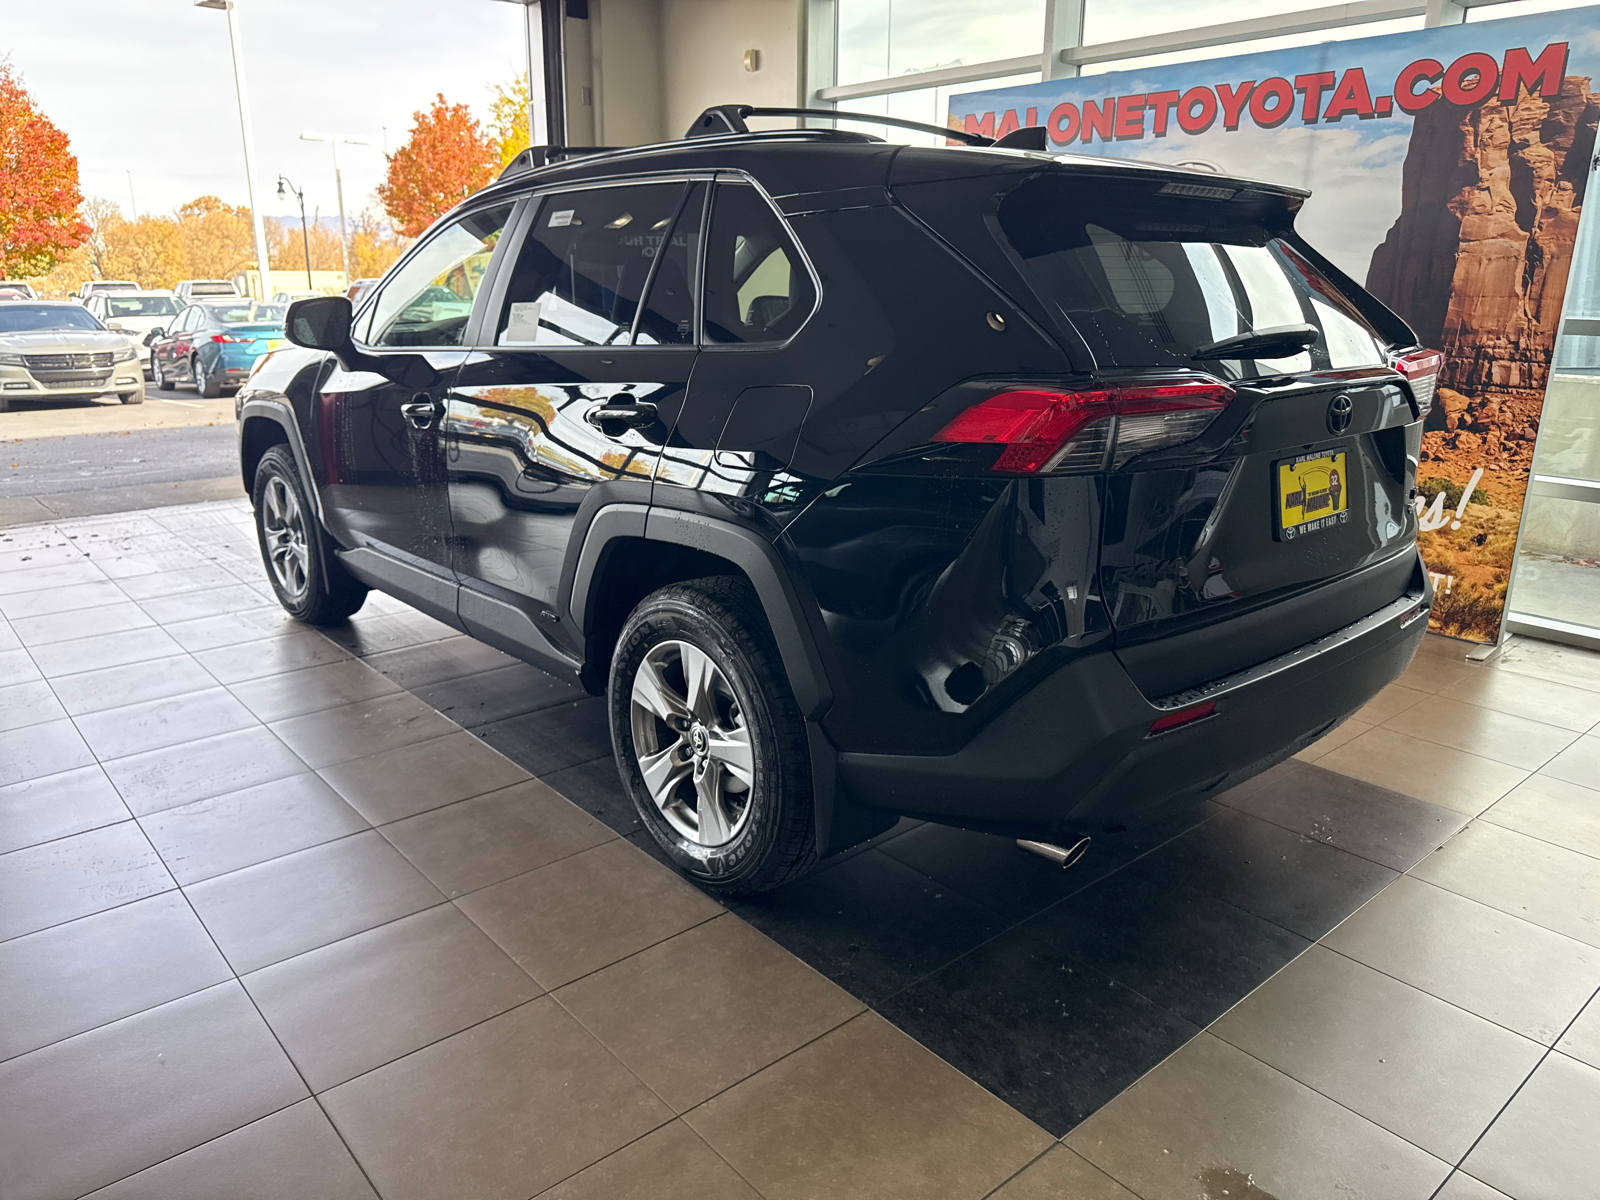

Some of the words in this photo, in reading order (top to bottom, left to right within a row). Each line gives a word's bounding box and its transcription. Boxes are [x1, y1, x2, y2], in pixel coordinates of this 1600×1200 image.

[1331, 475, 1338, 485] 32
[1285, 490, 1303, 510] KARL
[1306, 492, 1330, 513] MALONE
[1299, 525, 1306, 534] WE
[1307, 520, 1320, 532] MAKE
[1320, 519, 1326, 528] IT
[1326, 515, 1337, 526] EASY
[1429, 572, 1453, 595] T!
